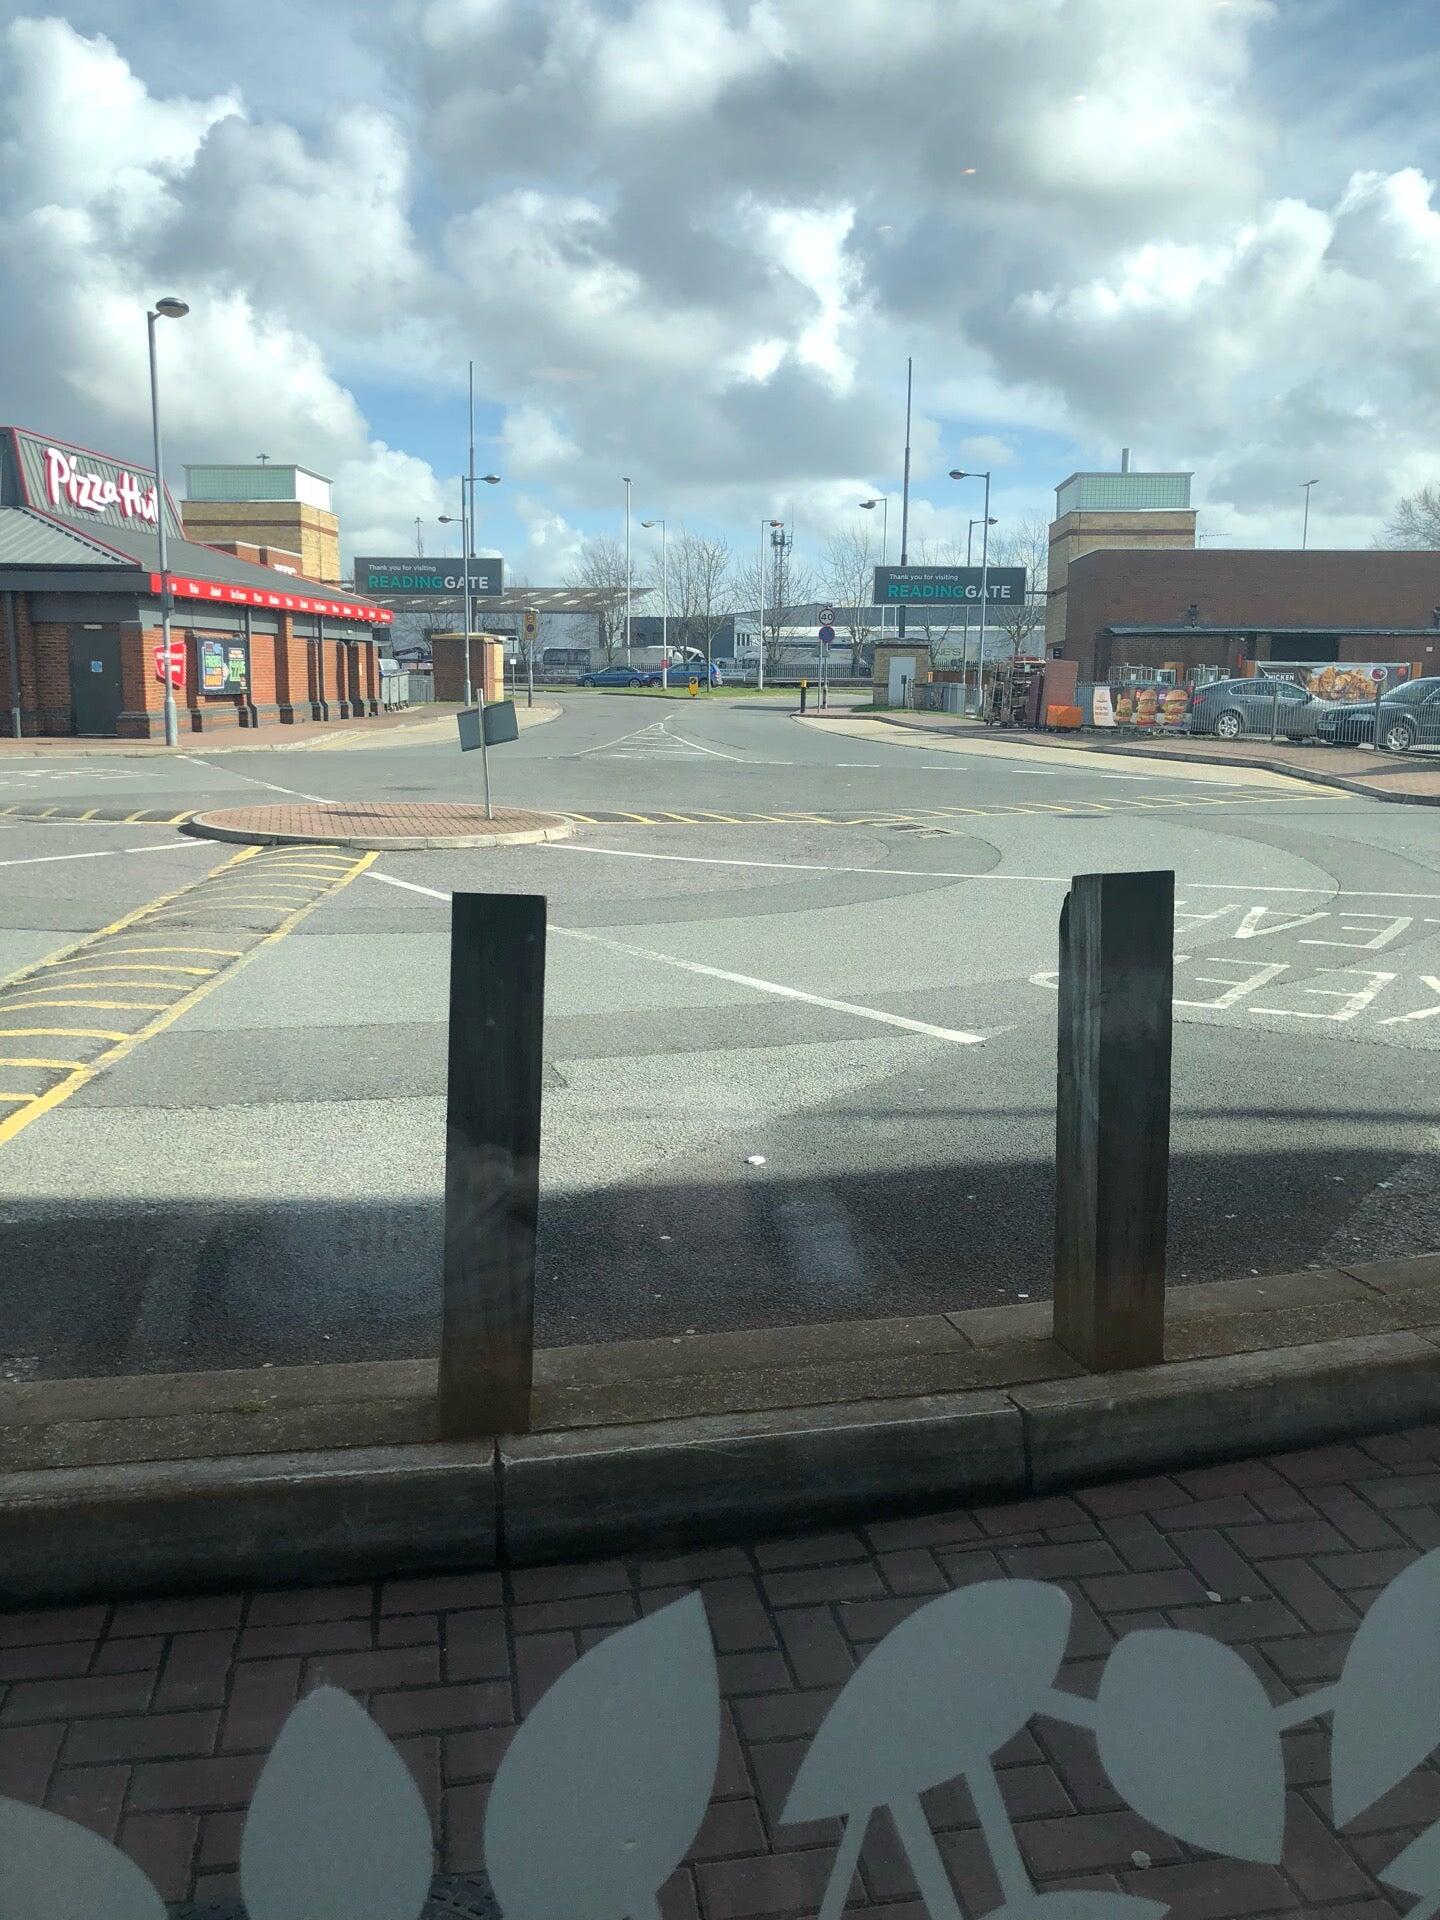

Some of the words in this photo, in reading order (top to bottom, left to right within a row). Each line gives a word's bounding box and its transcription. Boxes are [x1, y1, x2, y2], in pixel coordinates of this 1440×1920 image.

[45, 447, 121, 512] Pizza
[413, 564, 437, 572] visiting
[935, 573, 959, 581] visiting
